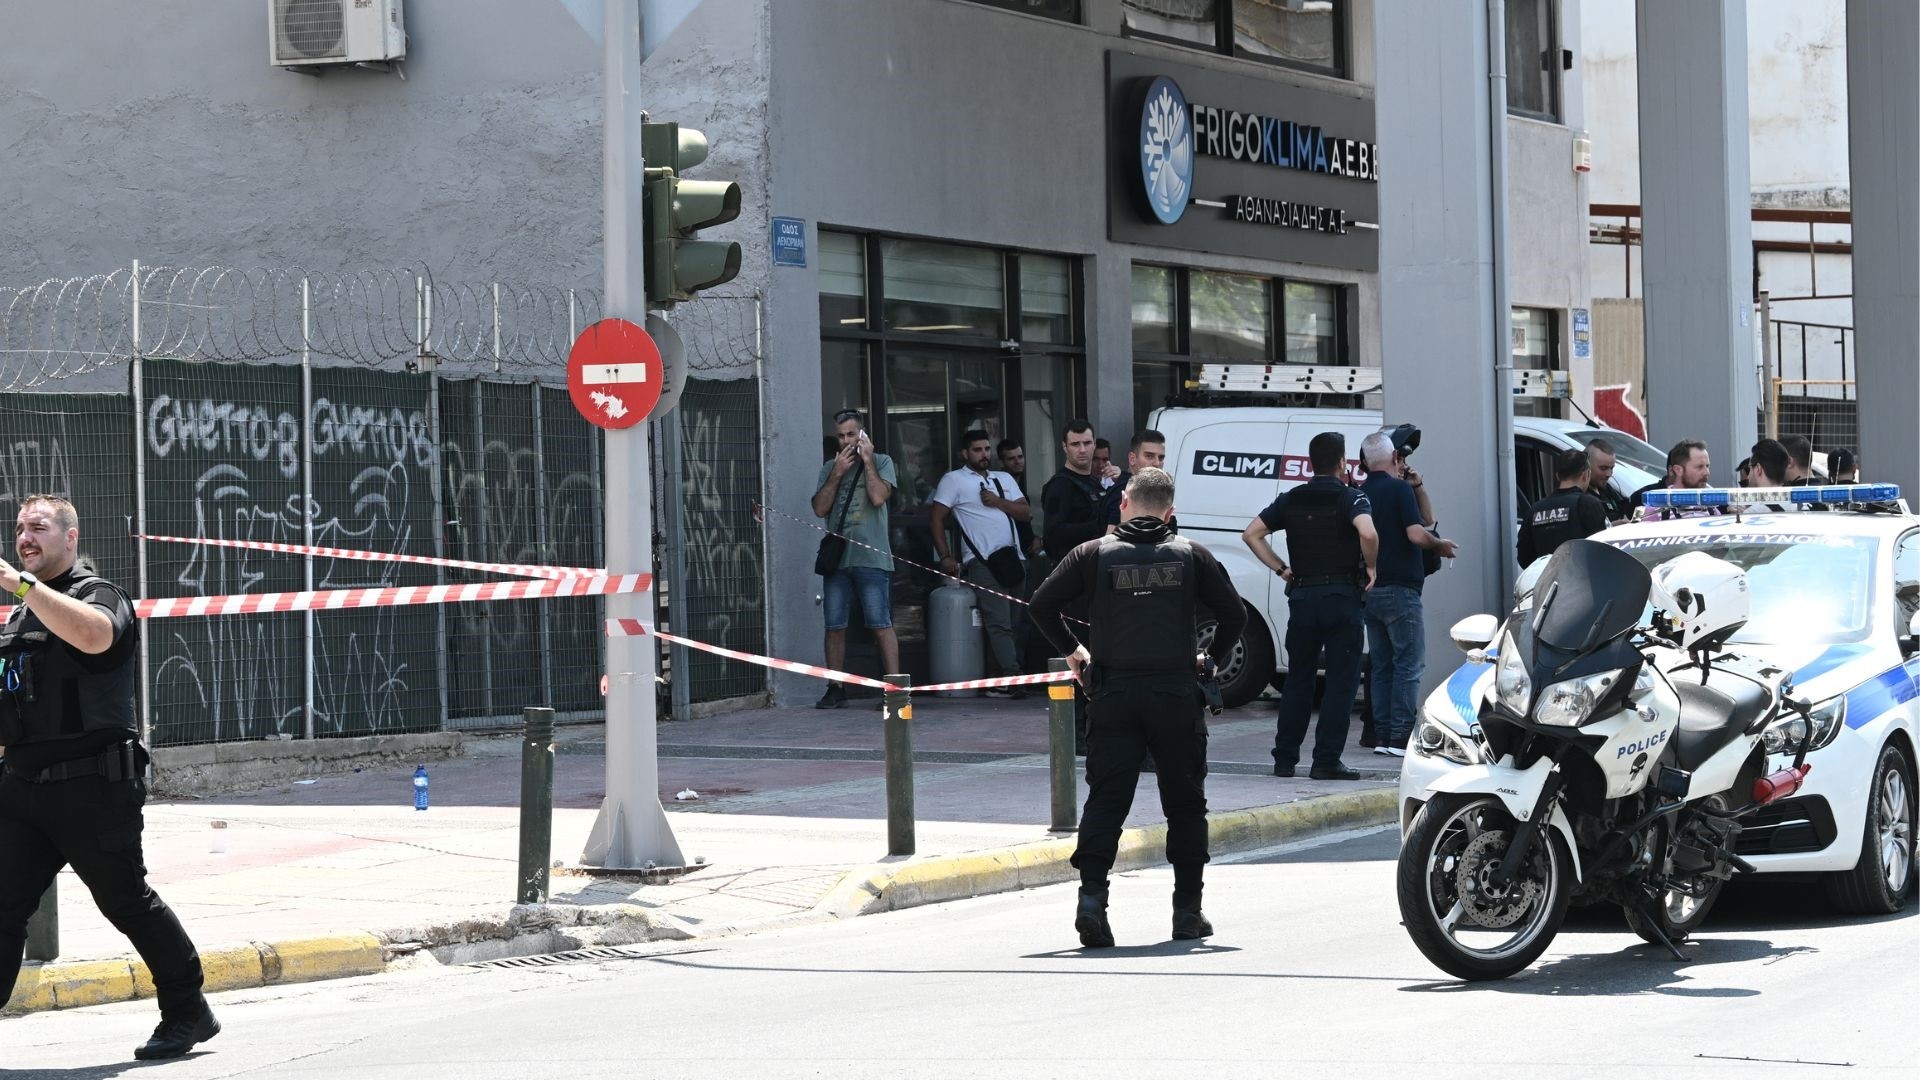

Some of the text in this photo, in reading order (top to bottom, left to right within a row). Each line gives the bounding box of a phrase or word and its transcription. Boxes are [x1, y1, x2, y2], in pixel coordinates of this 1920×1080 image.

[1193, 104, 1328, 173] FRIGOKLIMA
[781, 223, 799, 235] ΟΔΟΣ
[1236, 196, 1325, 232] ΑΘΑΝΑΣΙΑΔΗΣ
[1202, 454, 1275, 477] CLIMA
[1616, 729, 1667, 760] POLICE
